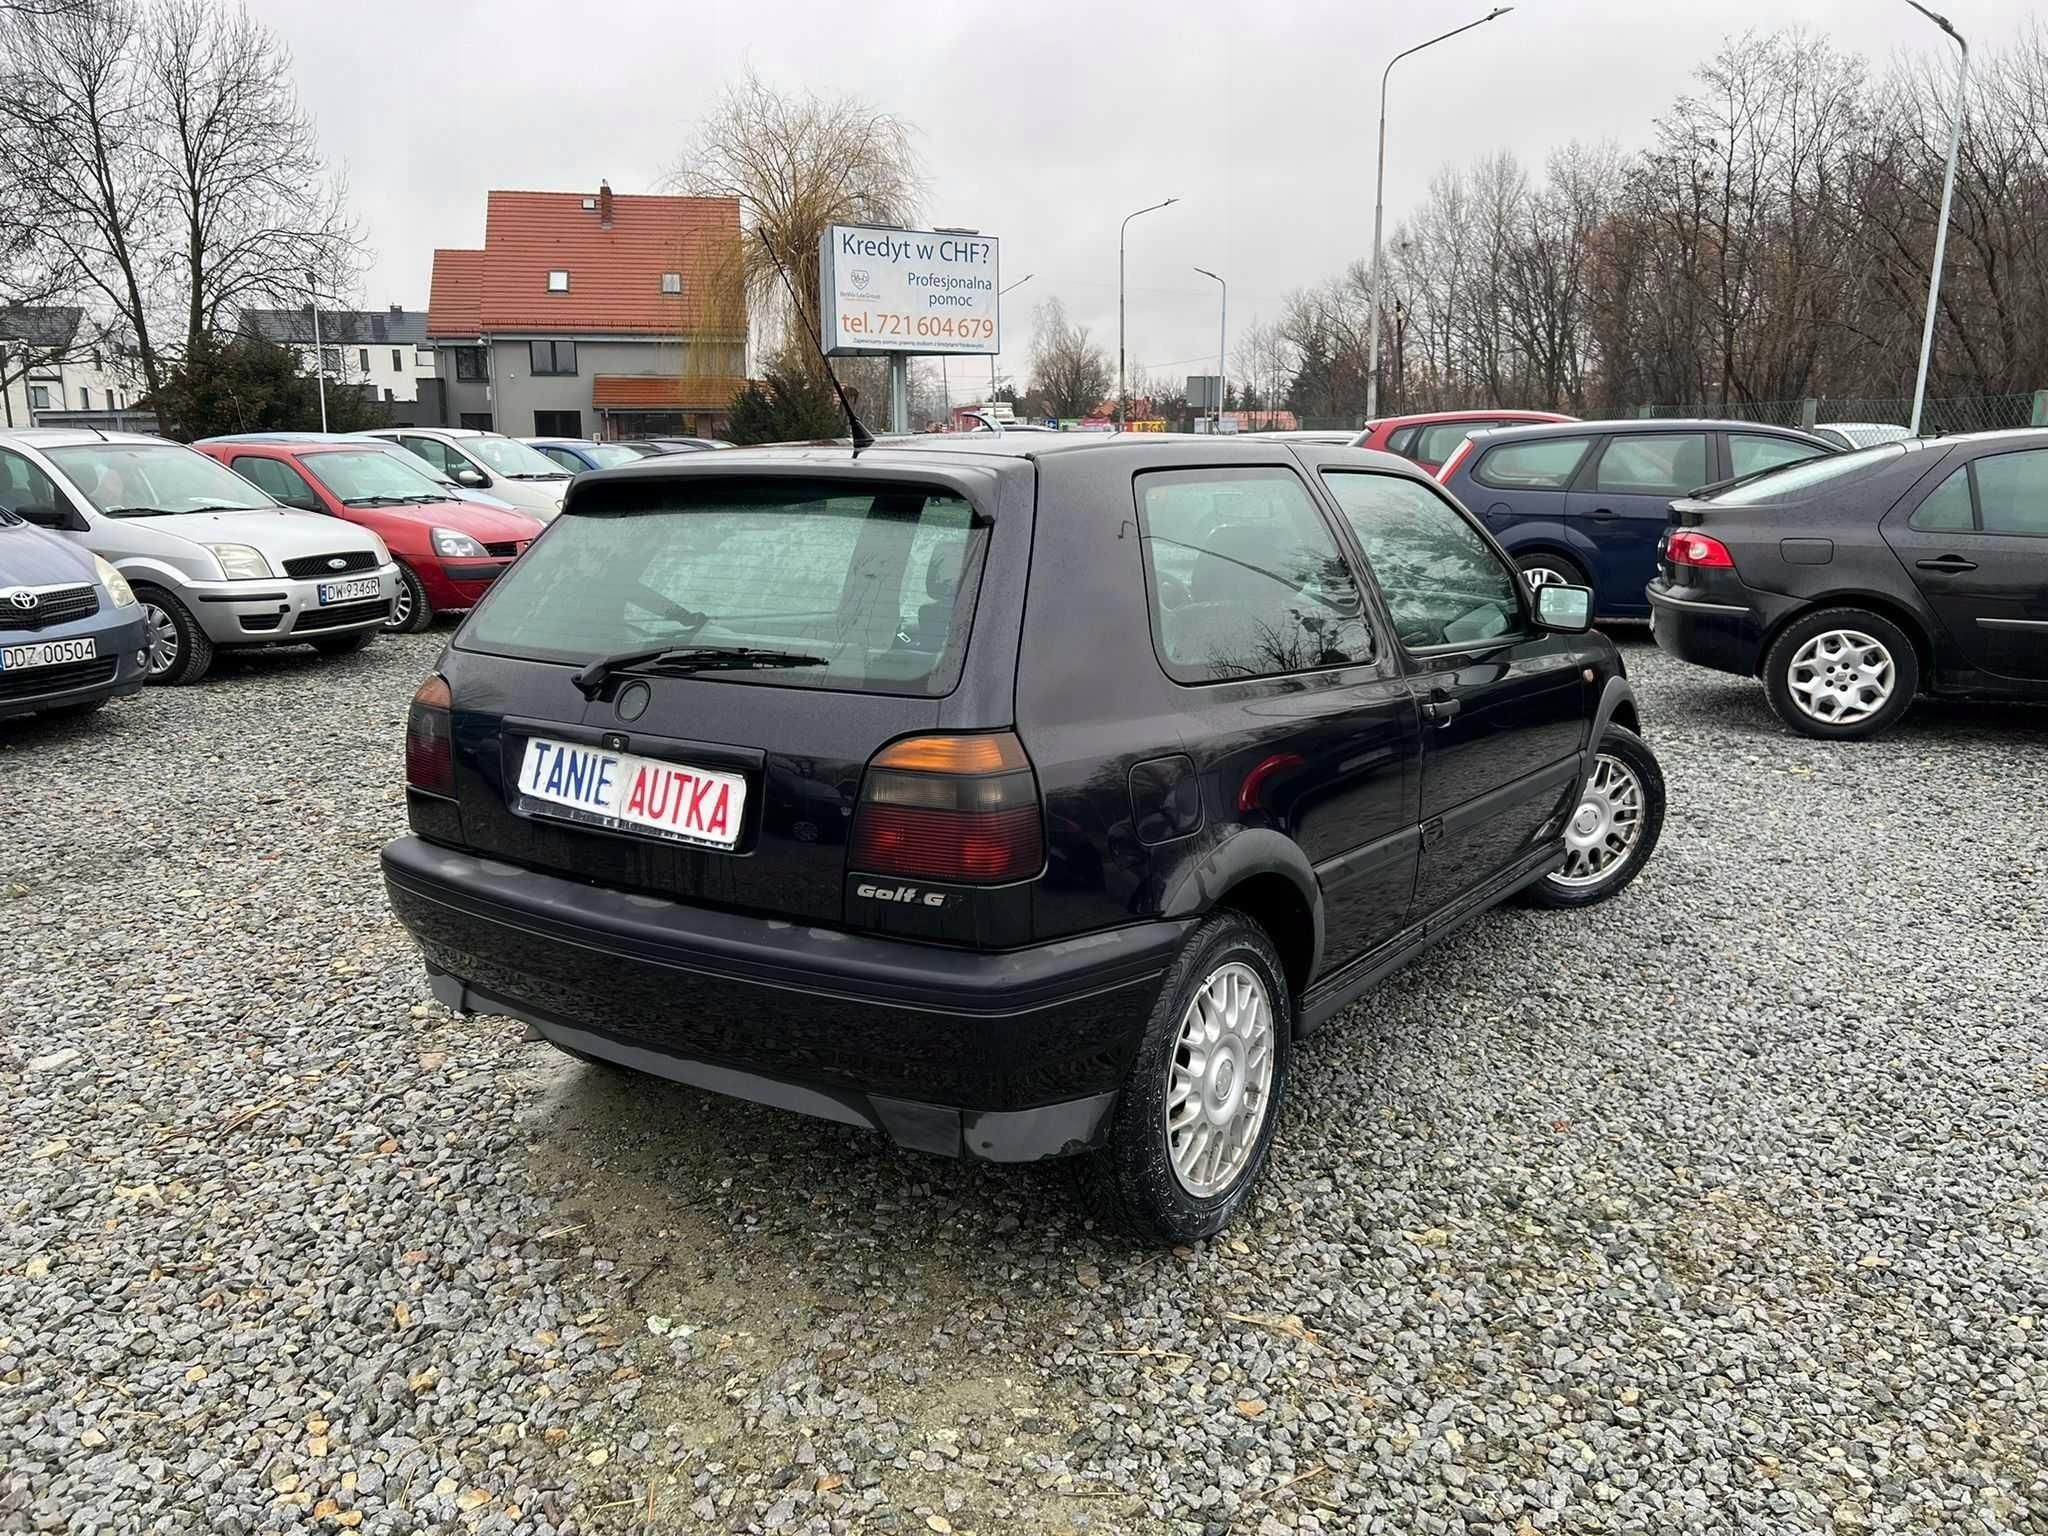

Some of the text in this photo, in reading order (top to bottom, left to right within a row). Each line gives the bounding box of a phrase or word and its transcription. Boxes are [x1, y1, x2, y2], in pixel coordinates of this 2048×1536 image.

[843, 233, 990, 264] Kredyt w CHF?
[908, 272, 992, 291] Profesjonalna
[929, 295, 973, 308] pomoc
[841, 312, 994, 339] tel. 721 604 679
[3, 640, 95, 669] DDZ 00504
[532, 741, 617, 806] TANIE
[627, 766, 731, 836] AUTKA
[857, 884, 918, 903] Golf
